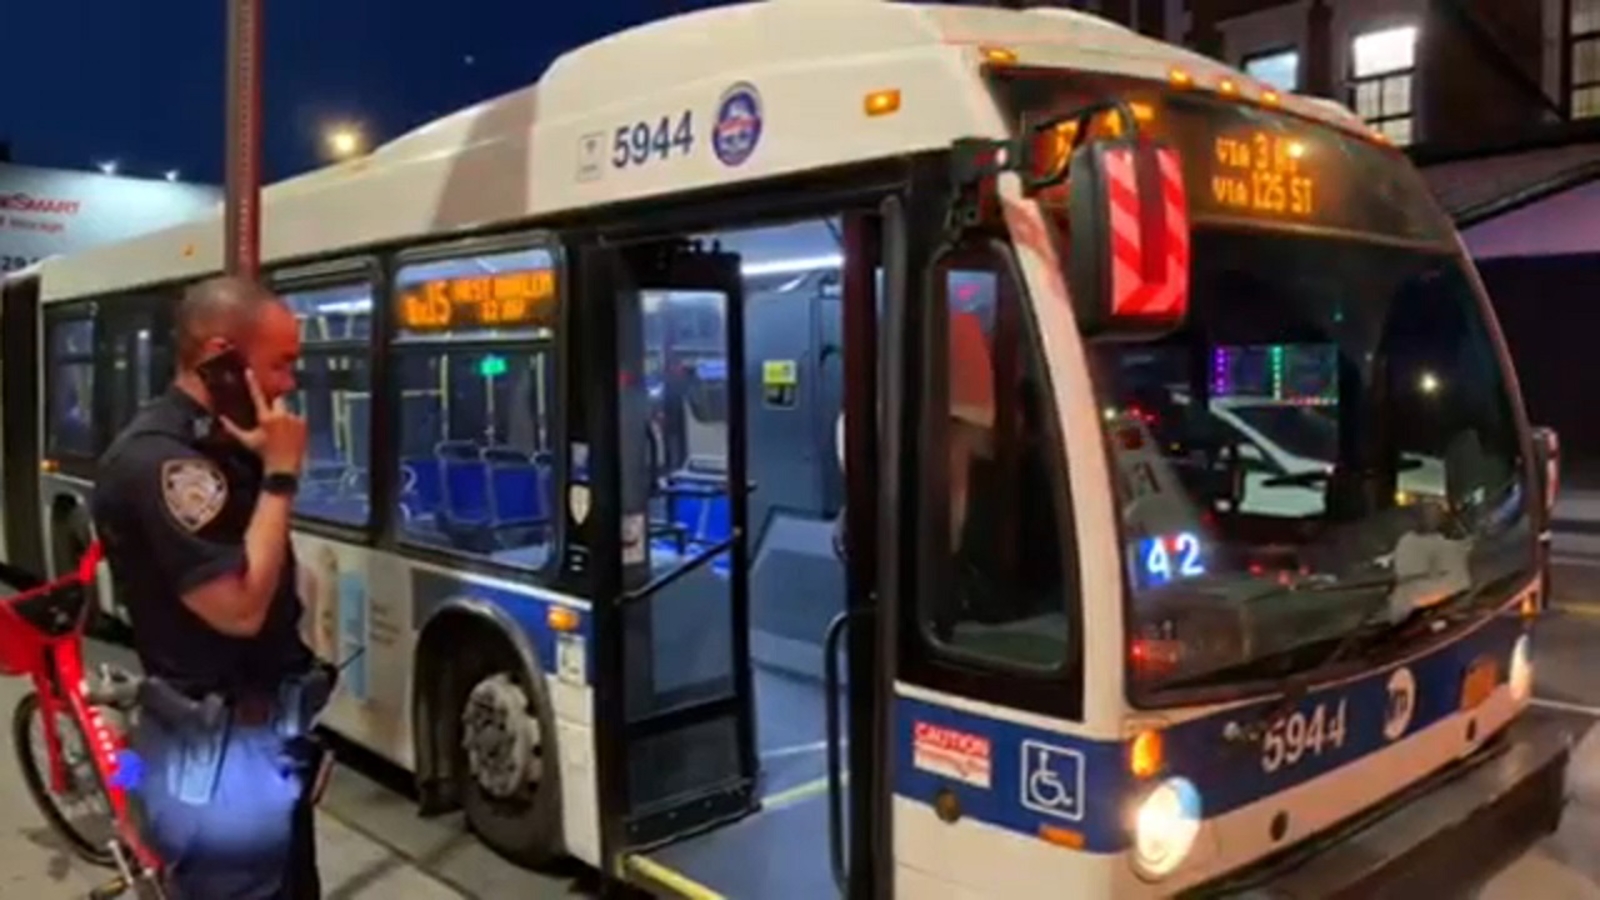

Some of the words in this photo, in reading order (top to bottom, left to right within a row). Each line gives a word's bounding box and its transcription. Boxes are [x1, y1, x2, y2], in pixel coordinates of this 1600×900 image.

[612, 109, 695, 169] 5944
[1211, 175, 1248, 207] VIA
[1251, 170, 1287, 212] 125
[1290, 176, 1313, 214] ST
[913, 720, 991, 758] CAUTION
[1262, 698, 1347, 773] 5944
